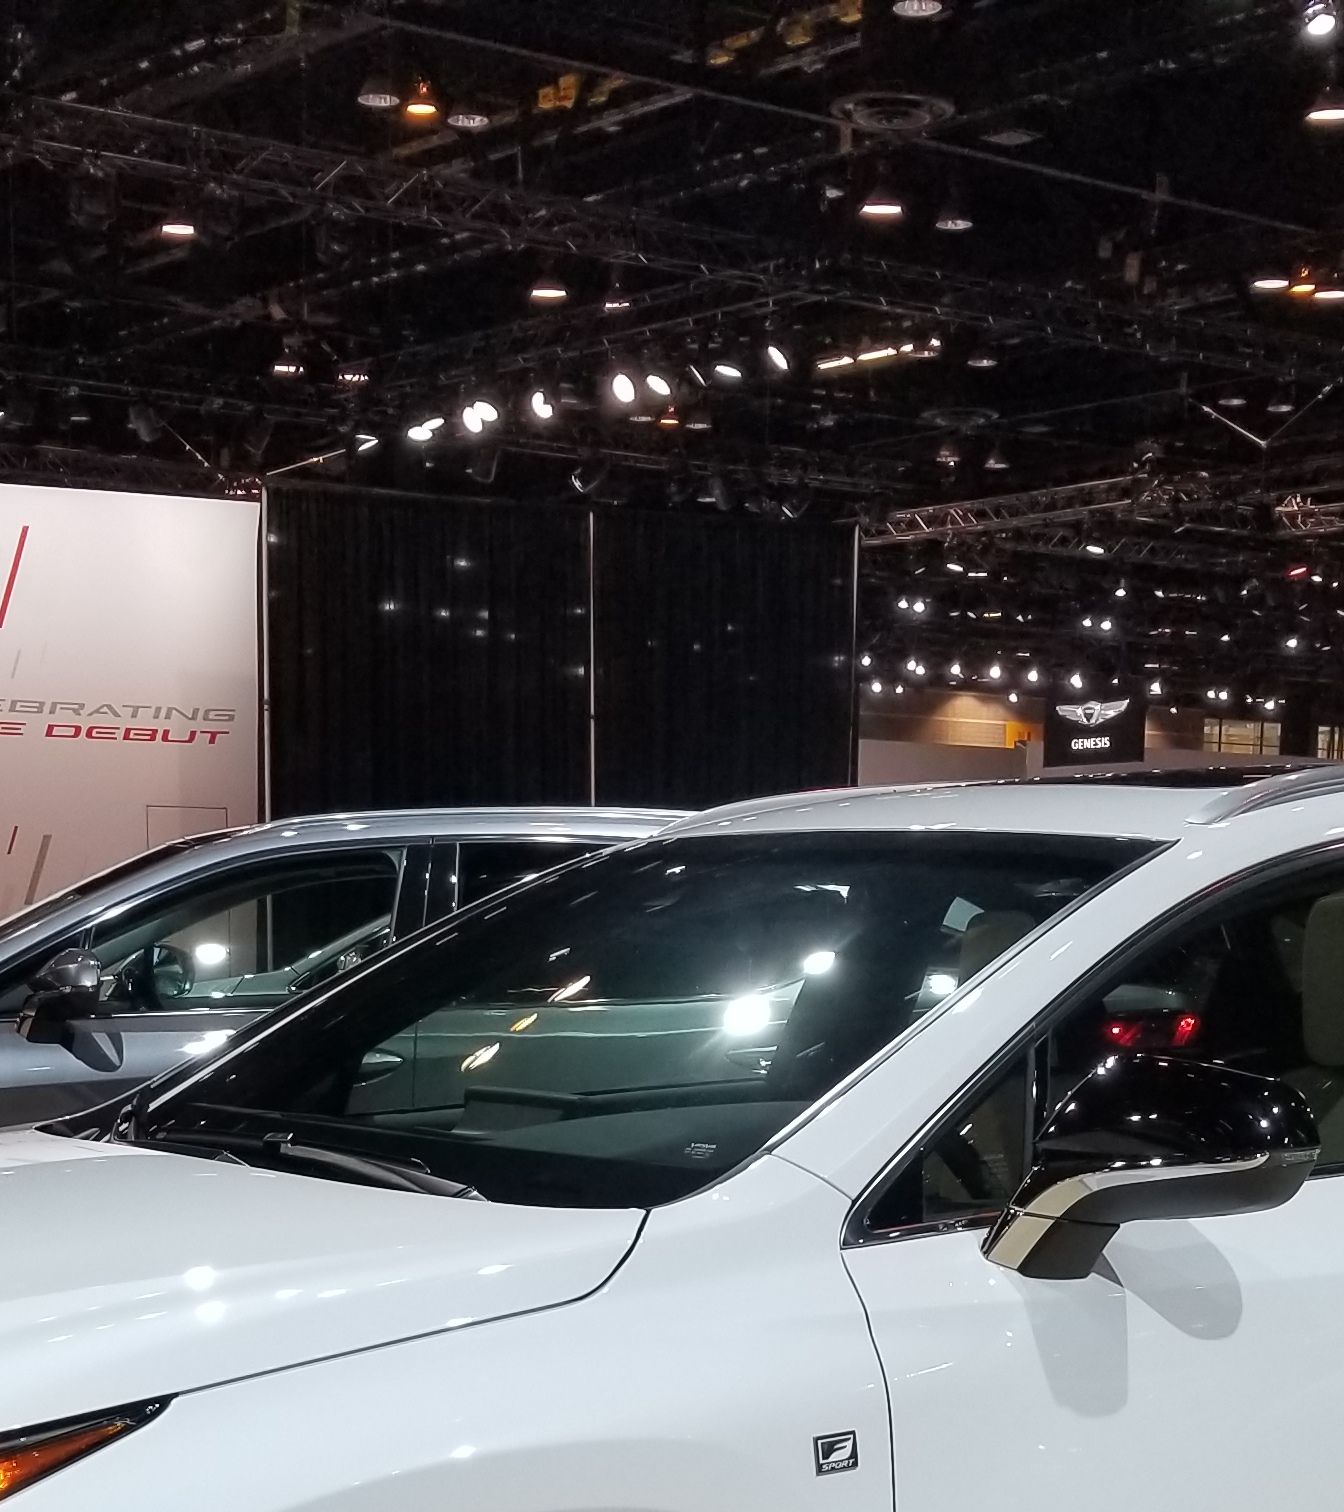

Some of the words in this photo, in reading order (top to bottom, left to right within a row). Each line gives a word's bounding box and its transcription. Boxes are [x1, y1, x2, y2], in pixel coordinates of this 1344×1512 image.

[44, 723, 231, 745] DEBUT
[1071, 736, 1111, 750] GENESIS
[821, 1458, 856, 1472] SPORT
